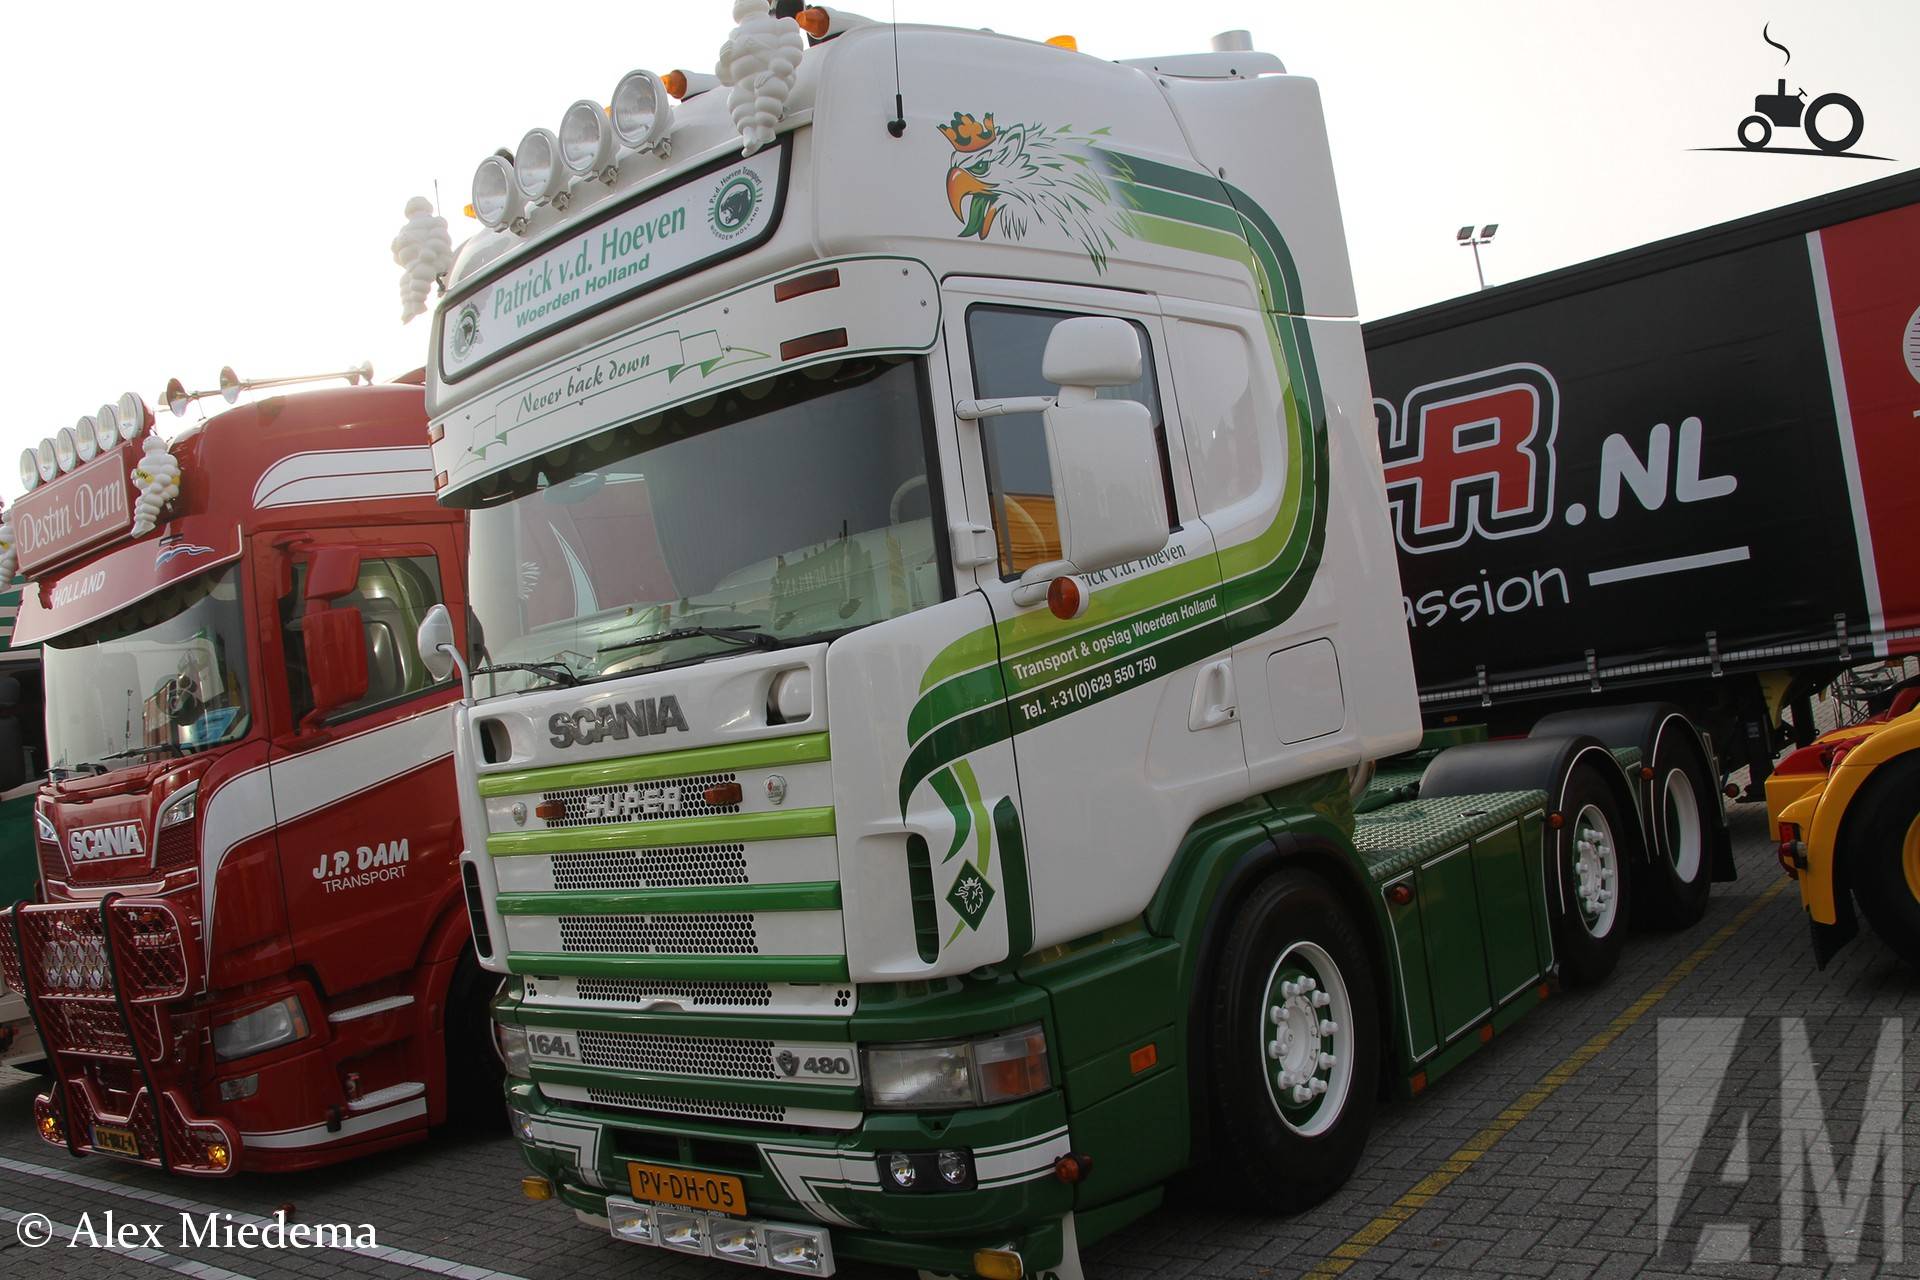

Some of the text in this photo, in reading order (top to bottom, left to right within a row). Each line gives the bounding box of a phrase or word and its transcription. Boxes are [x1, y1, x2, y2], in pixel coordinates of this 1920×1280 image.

[494, 206, 686, 320] Patrick v.d. Hoeven
[516, 253, 650, 329] Woerden Holland
[515, 352, 651, 422] Never back down
[18, 480, 123, 555] Destin Dam
[55, 570, 105, 608] HOLLAND
[1013, 594, 1217, 680] Transport & opslag Woerden Holland
[1020, 655, 1157, 720] Tel. +31(0)629 550 750
[548, 695, 689, 749] SCANIA
[585, 787, 681, 818] SUPER
[69, 823, 145, 860] SCANIA
[313, 838, 410, 879] J.P. DAM
[323, 865, 406, 893] TRANSPORT
[528, 1033, 576, 1058] 164L
[803, 1056, 850, 1076] 480
[638, 1169, 734, 1207] PV-DH-05
